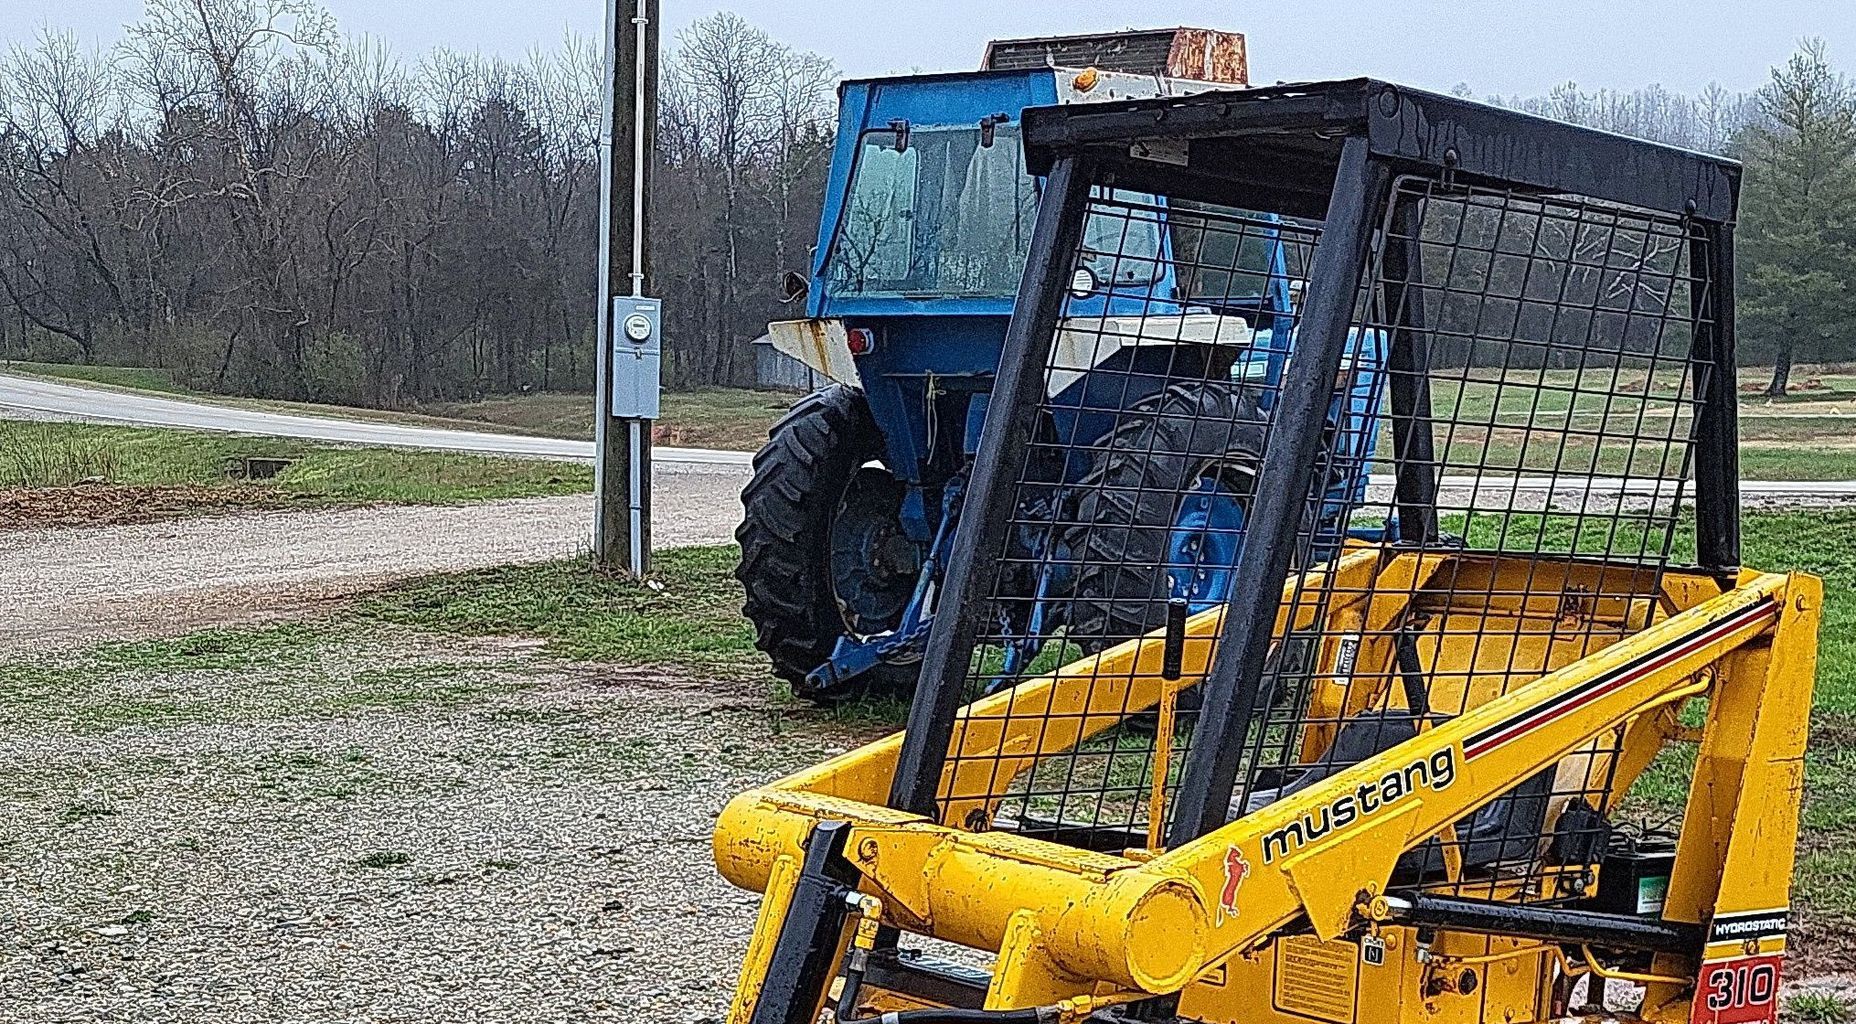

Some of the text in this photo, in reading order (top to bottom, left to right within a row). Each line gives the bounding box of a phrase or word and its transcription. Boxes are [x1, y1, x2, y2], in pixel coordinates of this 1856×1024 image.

[1262, 745, 1456, 864] mustang
[1715, 918, 1786, 935] HYDROSTATIC
[1707, 964, 1774, 1011] 310
